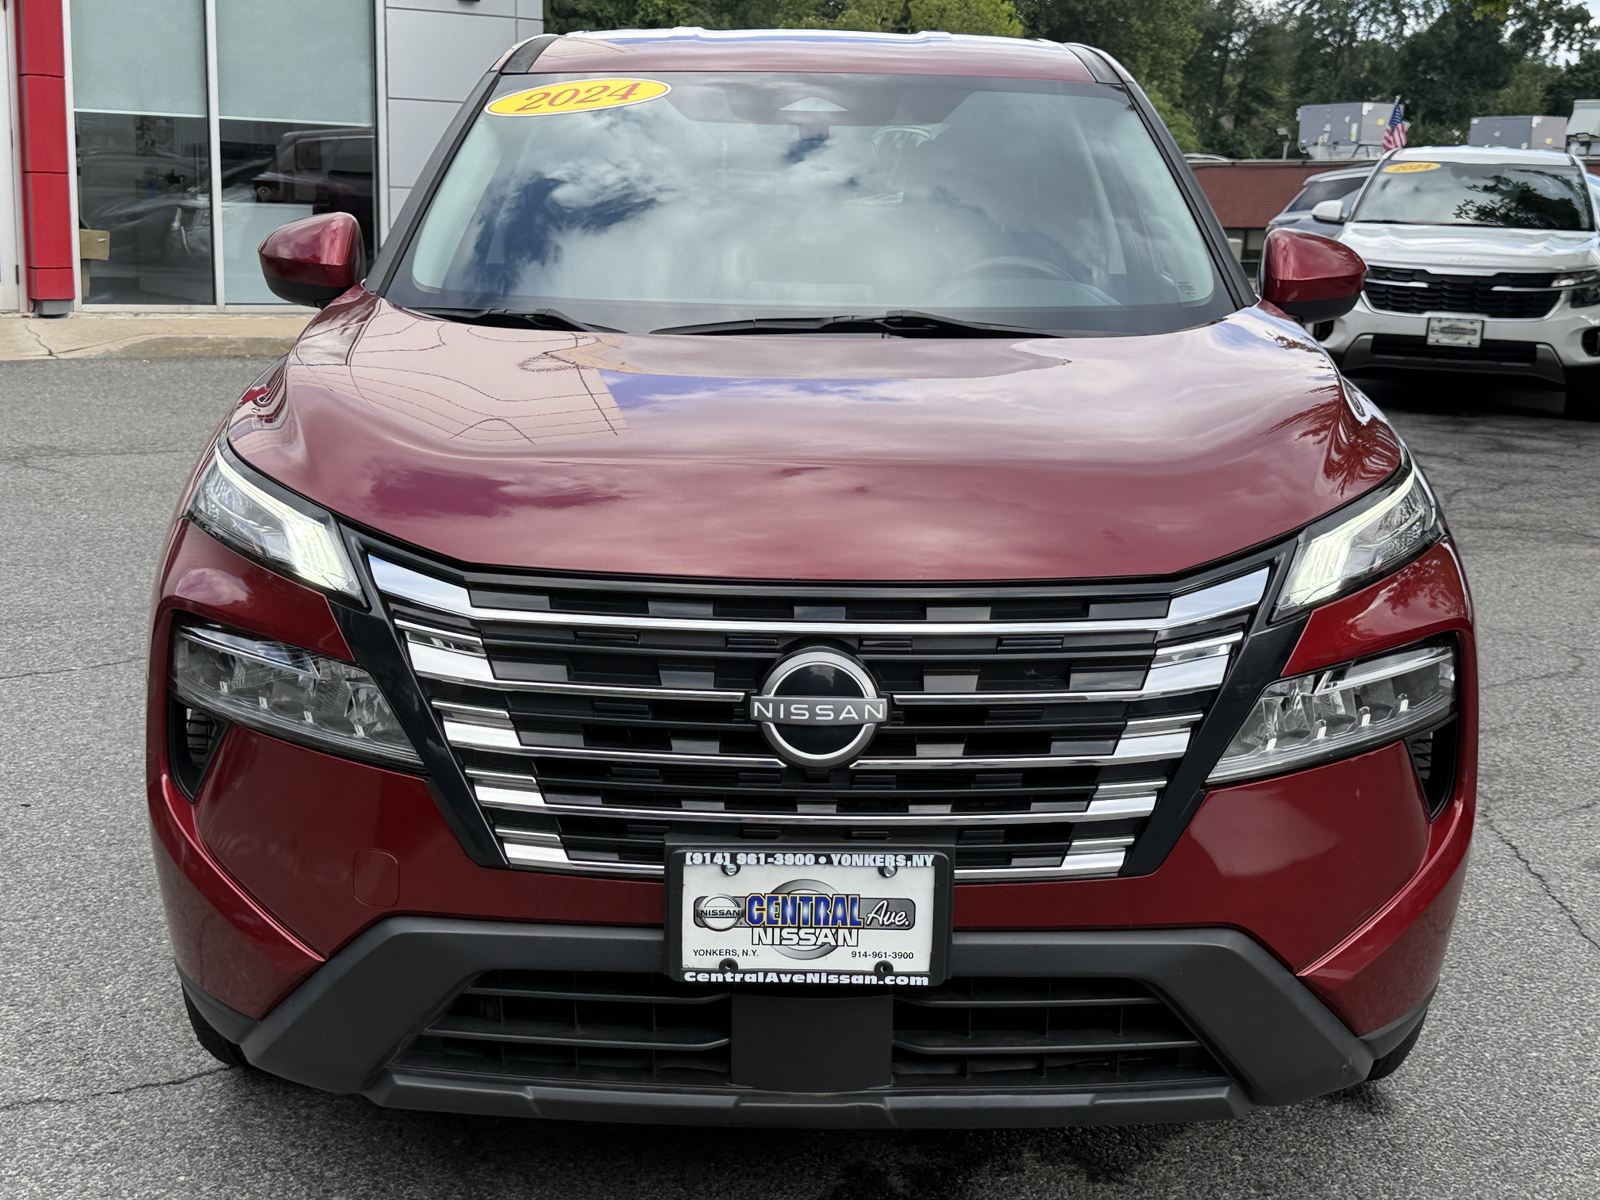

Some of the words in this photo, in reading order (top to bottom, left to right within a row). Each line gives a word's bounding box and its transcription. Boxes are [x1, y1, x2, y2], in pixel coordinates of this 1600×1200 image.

[514, 82, 641, 112] 2024
[753, 701, 884, 721] NISSAN
[736, 852, 816, 866] 961-3900
[700, 909, 740, 917] NISSAN
[745, 893, 864, 927] CENTRAL
[866, 899, 911, 926] Ave.
[752, 927, 859, 947] NISSAN
[693, 949, 740, 957] YONKERS,
[741, 949, 759, 958] N.Y.
[851, 951, 914, 960] 914-961-3900
[684, 971, 929, 986] CentralAveNissan.com
